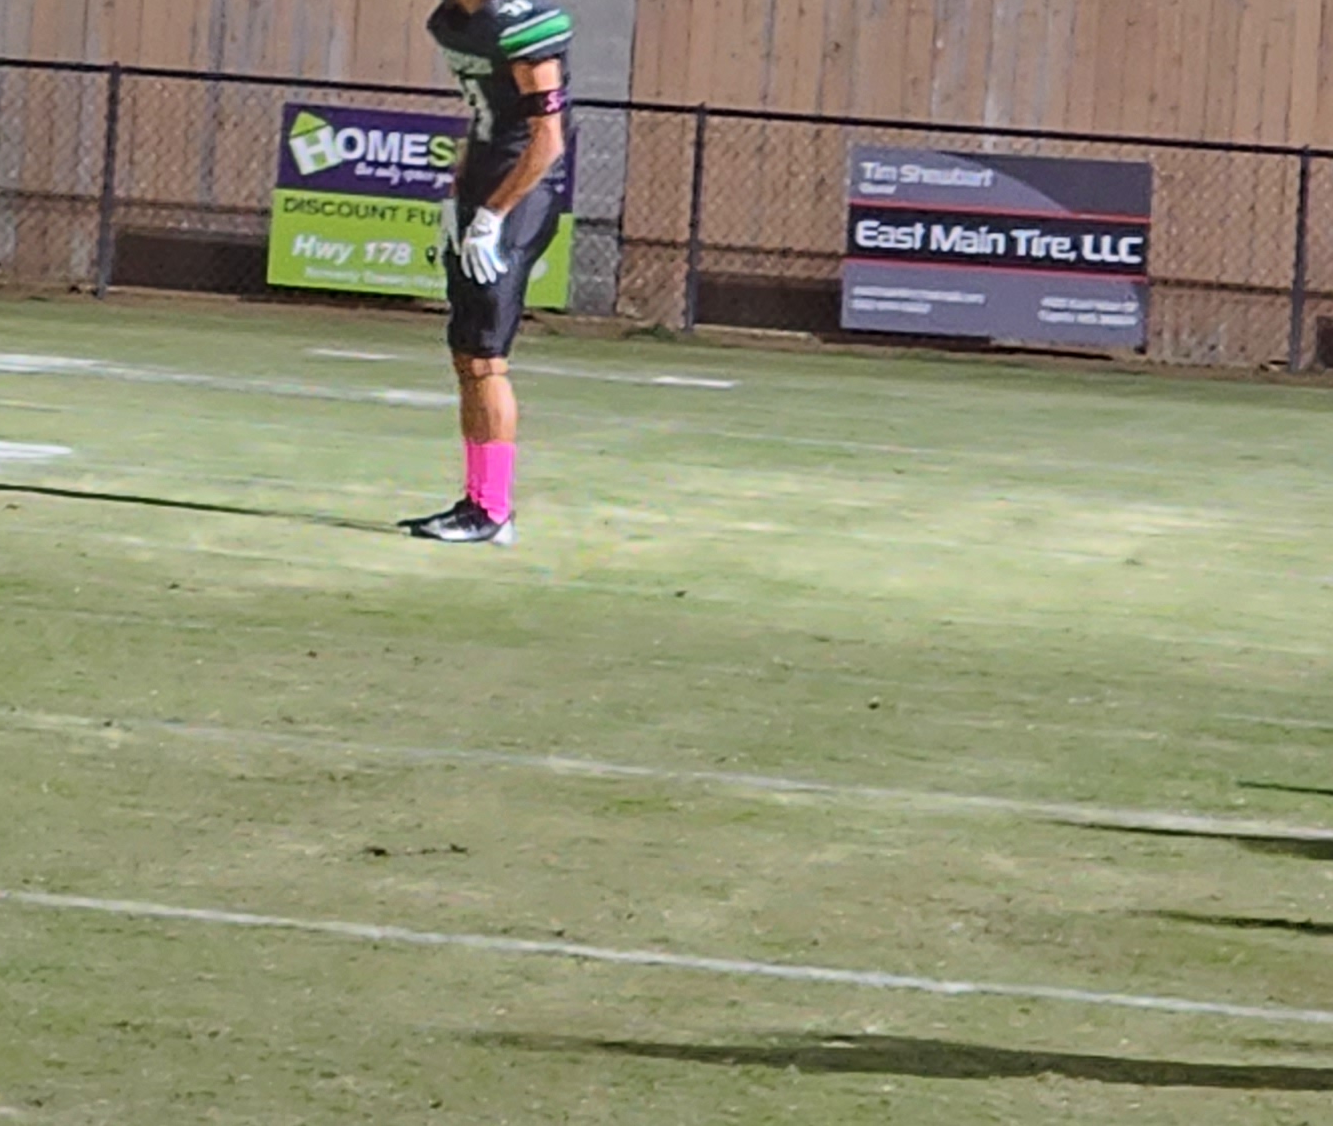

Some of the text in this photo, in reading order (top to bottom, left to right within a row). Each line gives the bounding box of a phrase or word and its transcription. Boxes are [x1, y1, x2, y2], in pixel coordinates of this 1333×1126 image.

[284, 197, 442, 226] DISCOUNT FU
[292, 234, 412, 266] Hwy 178
[855, 219, 1144, 264] East Main Tire, LLC
